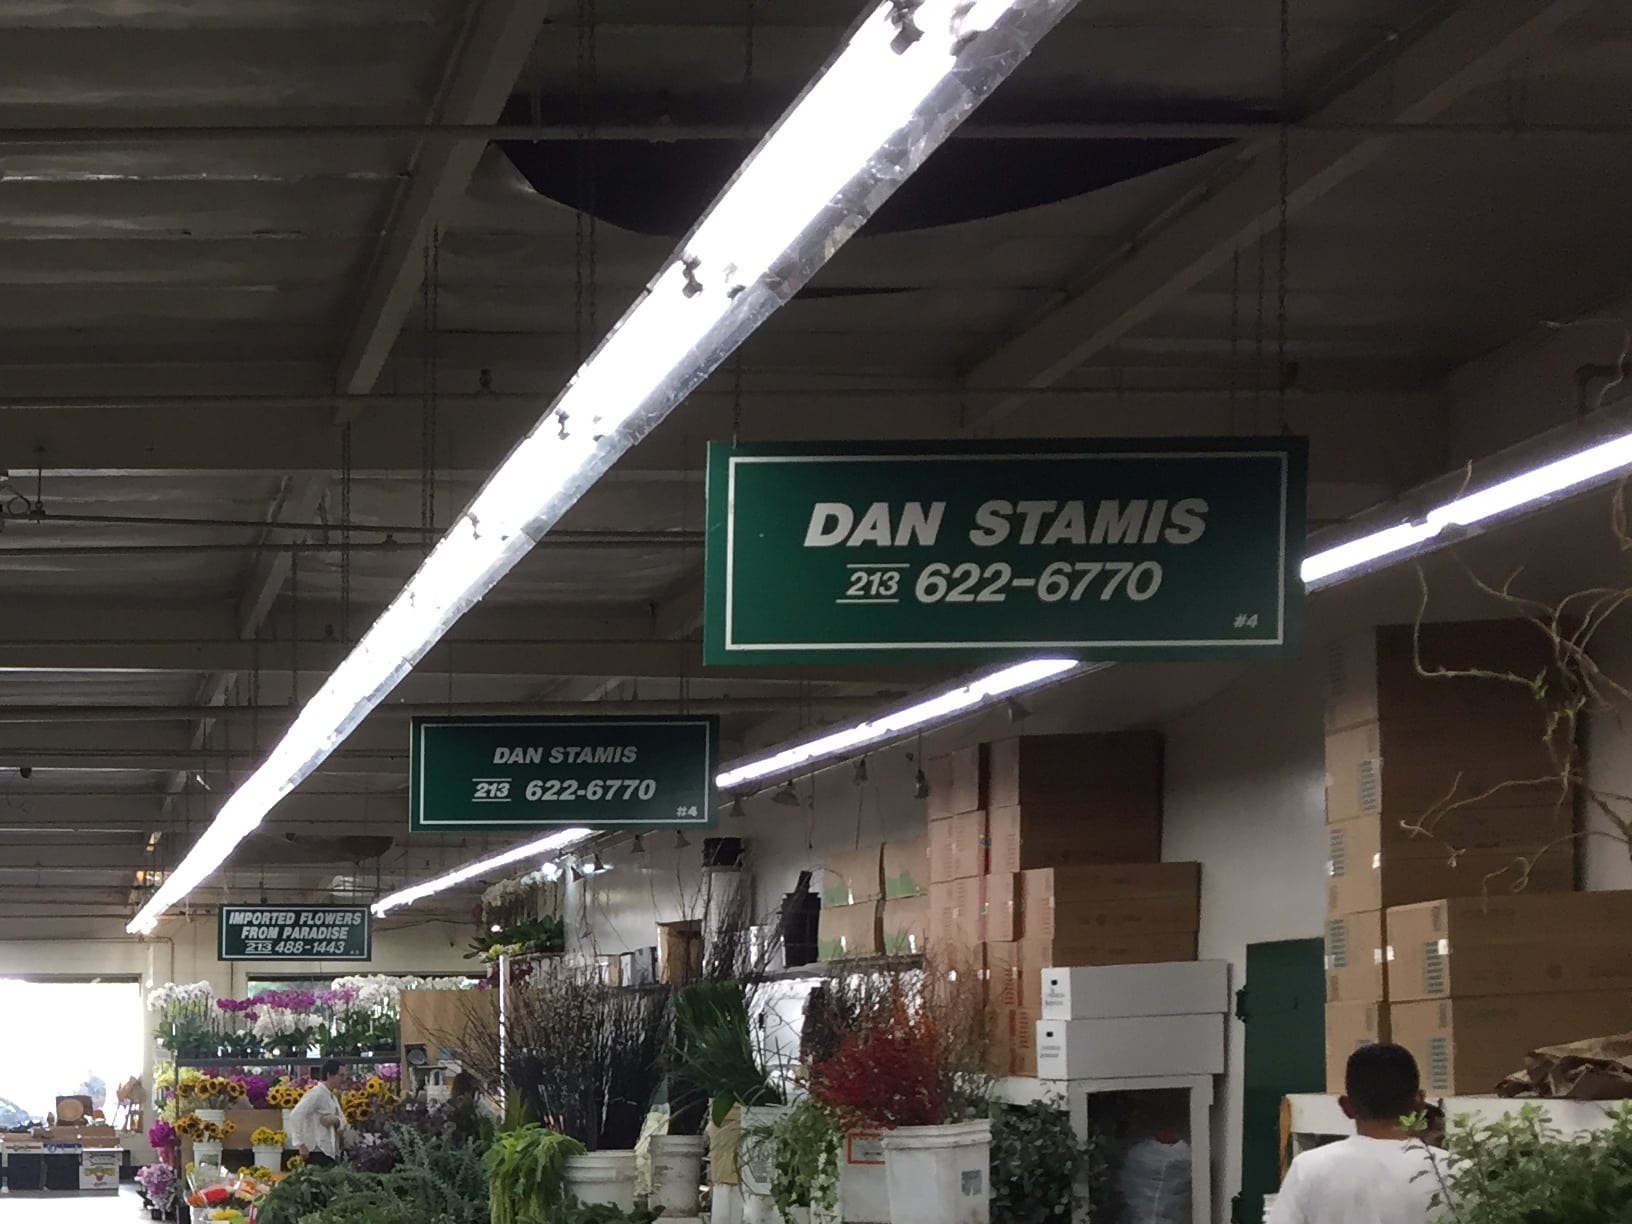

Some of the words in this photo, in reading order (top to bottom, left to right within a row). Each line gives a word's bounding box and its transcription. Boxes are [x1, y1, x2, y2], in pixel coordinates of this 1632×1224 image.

[804, 502, 946, 547] DAN
[969, 499, 1209, 545] STAMIS
[846, 570, 900, 597] 213
[915, 561, 1163, 603] 622-6770
[1233, 613, 1259, 629] #4
[493, 747, 543, 764] DAN
[548, 745, 638, 764] STAMIS
[474, 782, 510, 798] 213
[525, 779, 657, 801] 622-6770
[229, 912, 296, 925] IMPORTED
[299, 912, 362, 925] FLOWERS
[241, 926, 279, 939] FROM
[282, 926, 350, 940] PARADISE
[246, 942, 272, 951] 213
[275, 940, 345, 953] 488-1443
